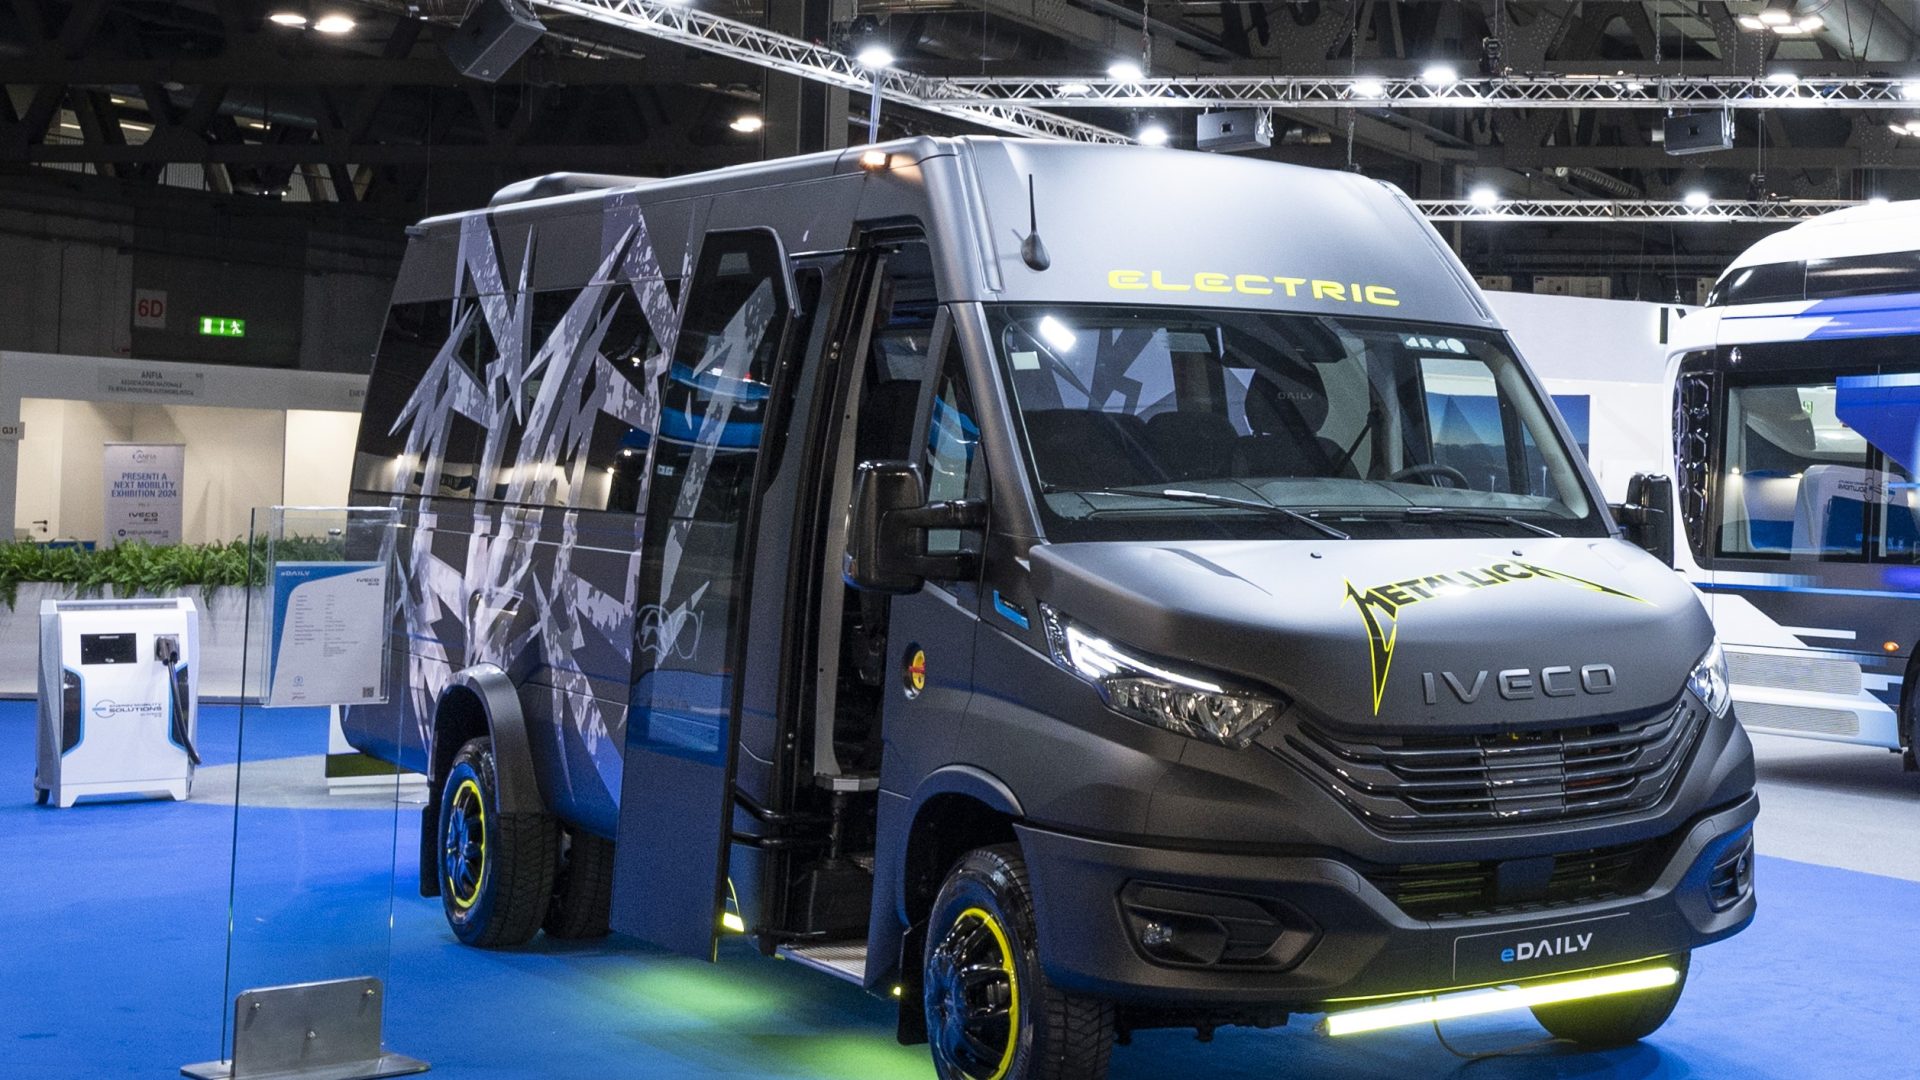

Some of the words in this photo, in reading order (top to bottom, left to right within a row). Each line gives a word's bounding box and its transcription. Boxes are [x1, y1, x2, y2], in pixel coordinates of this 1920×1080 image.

[1107, 269, 1400, 307] ELECTRIC
[138, 299, 163, 317] 6D
[141, 370, 163, 379] ANFIA
[1277, 391, 1313, 400] DAILY
[2, 426, 18, 435] G31
[122, 472, 159, 480] PRESENTI
[161, 472, 167, 480] A
[113, 481, 135, 489] NEXT
[137, 481, 175, 489] MOBILITY
[111, 489, 156, 498] EXHIBITION
[157, 489, 177, 498] 2024
[1421, 663, 1618, 705] IVECO
[1500, 932, 1593, 963] eDAILY
